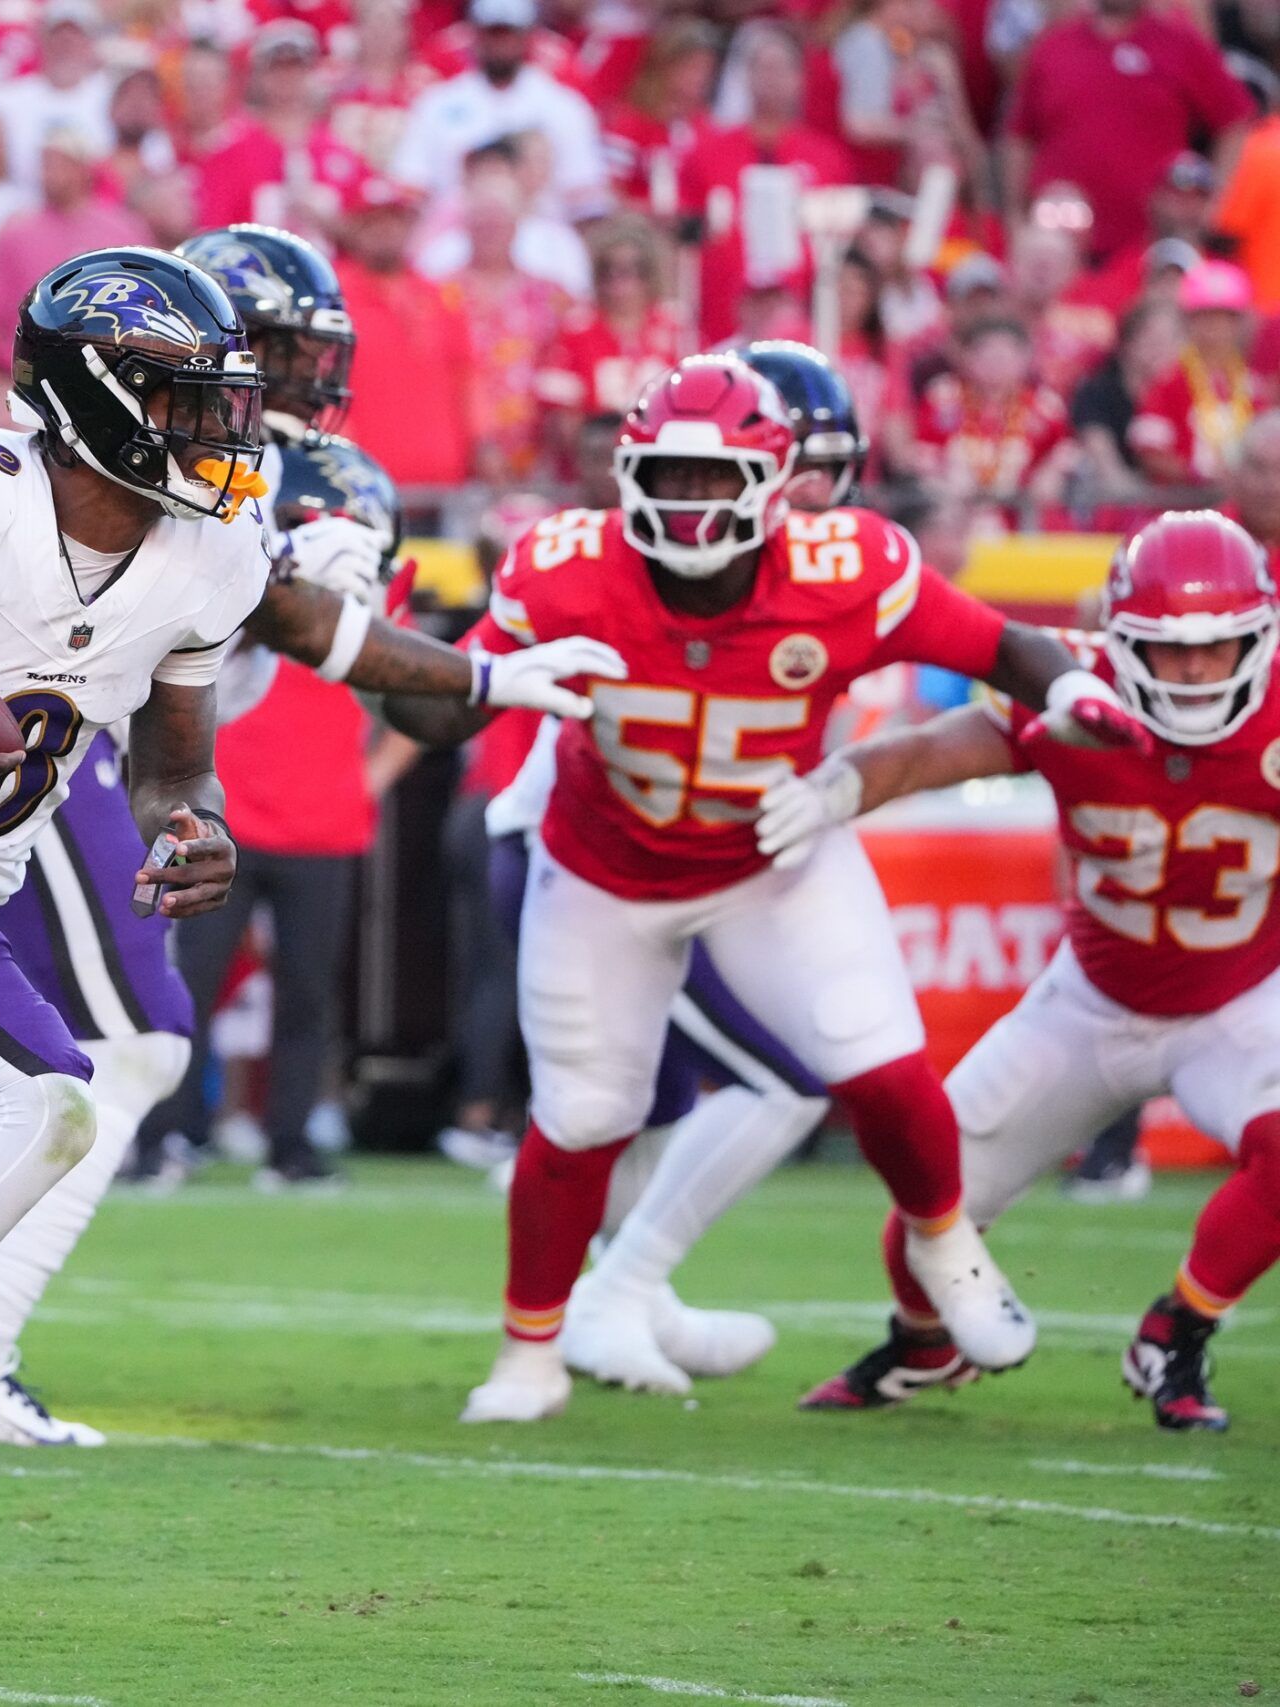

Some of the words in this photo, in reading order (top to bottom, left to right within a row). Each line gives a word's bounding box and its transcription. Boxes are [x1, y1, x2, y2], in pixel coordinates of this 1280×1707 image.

[182, 363, 218, 372] OAKLEY
[532, 507, 608, 571] 55
[785, 510, 864, 584] 55
[26, 672, 88, 684] RAVENS
[589, 679, 812, 830] 55
[1069, 801, 1280, 952] 23
[889, 904, 1065, 990] GAT
